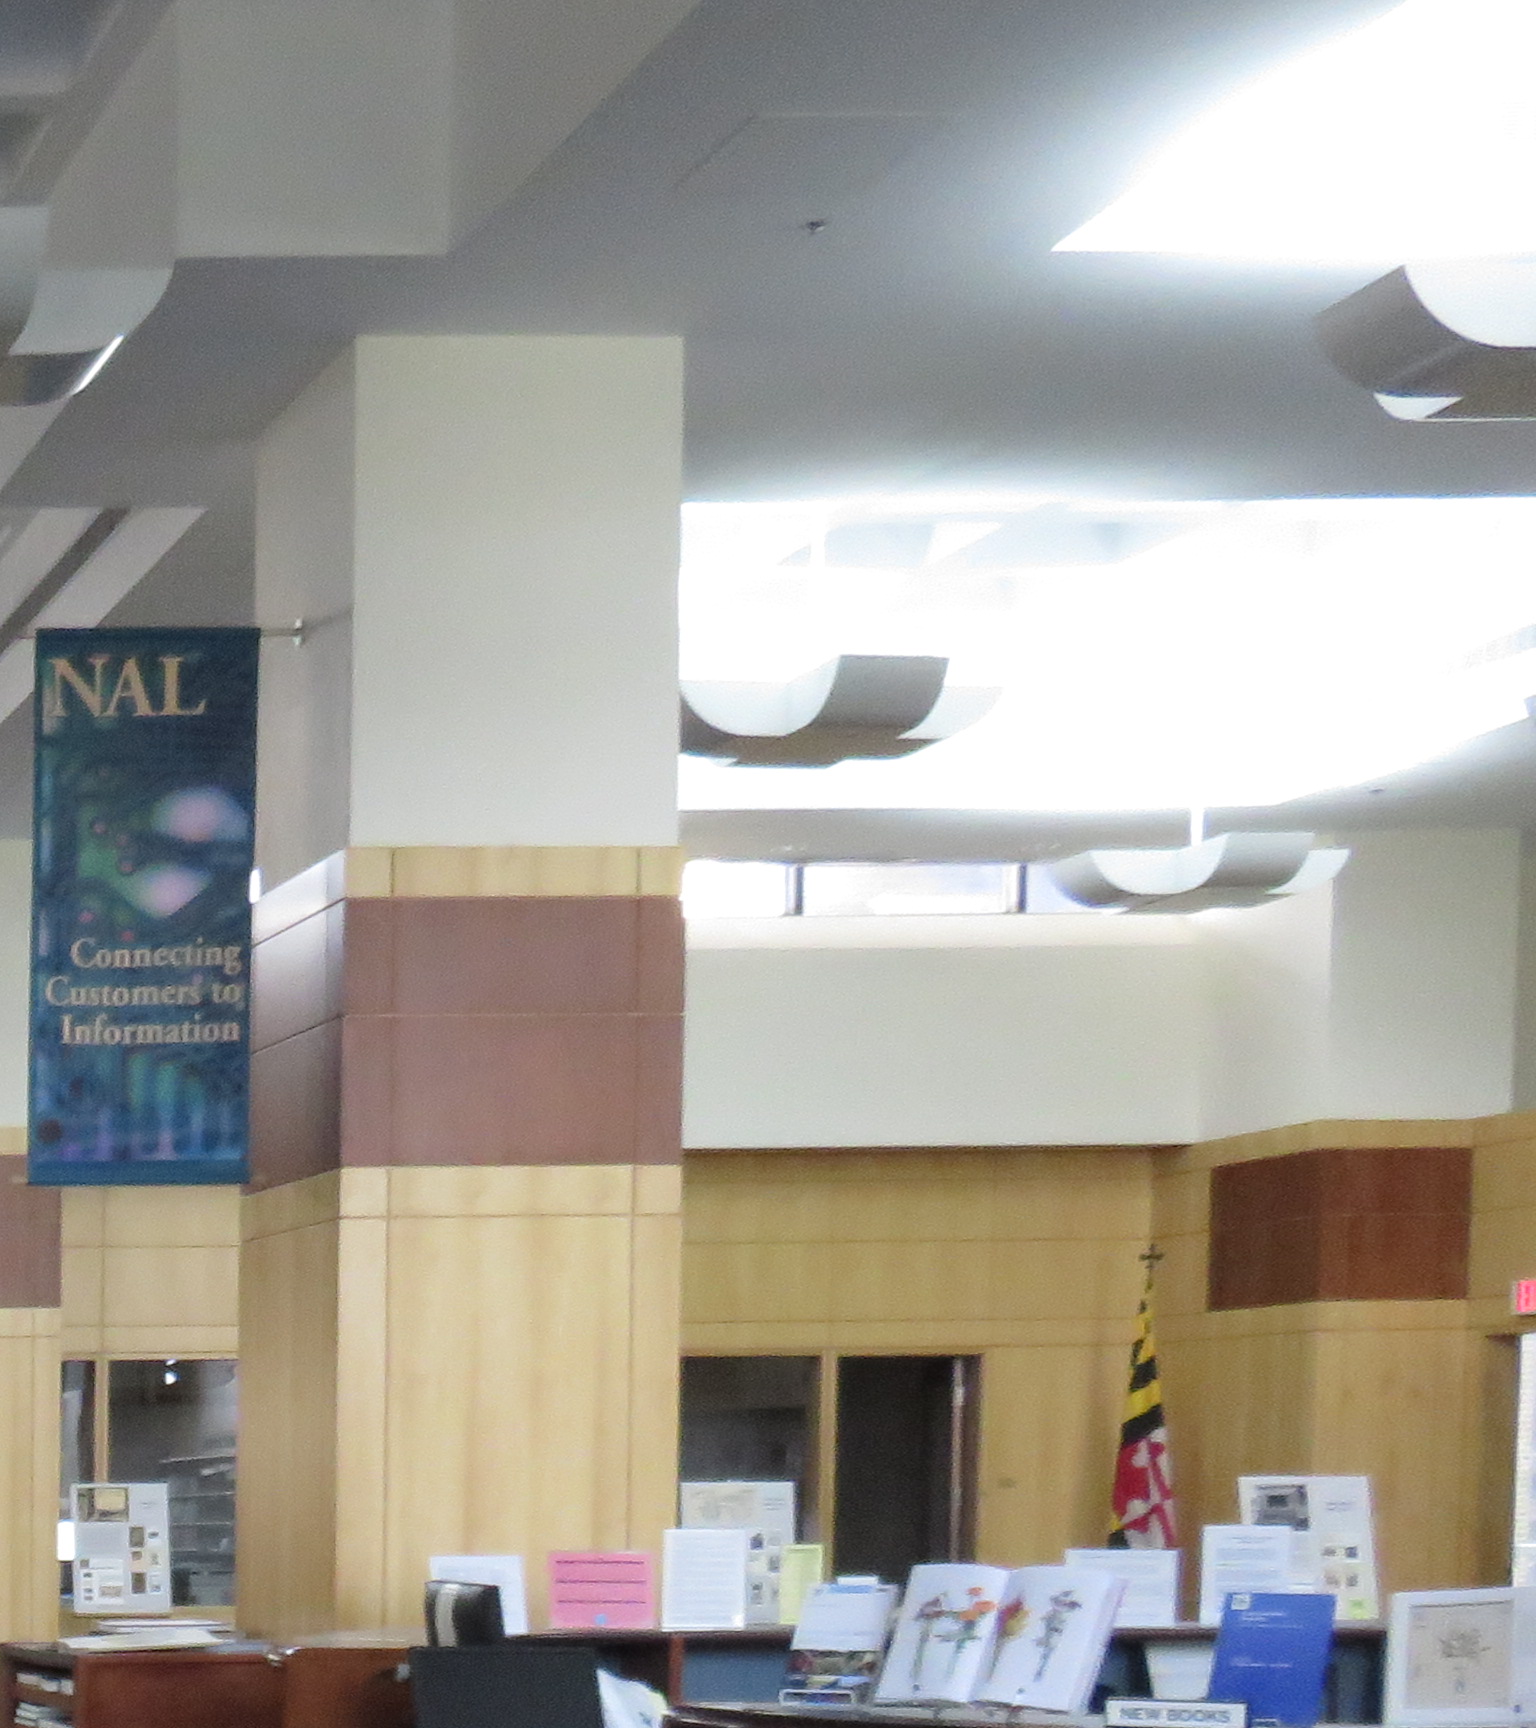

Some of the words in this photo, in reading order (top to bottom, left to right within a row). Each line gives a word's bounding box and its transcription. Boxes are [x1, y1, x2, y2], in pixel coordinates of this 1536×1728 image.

[48, 655, 206, 719] NAL
[70, 937, 242, 976] Connecting
[45, 976, 200, 1007] Customers
[210, 978, 241, 1006] to
[60, 1010, 241, 1046] Information
[1119, 1707, 1161, 1721] NEW
[1166, 1709, 1233, 1723] BOOKS
